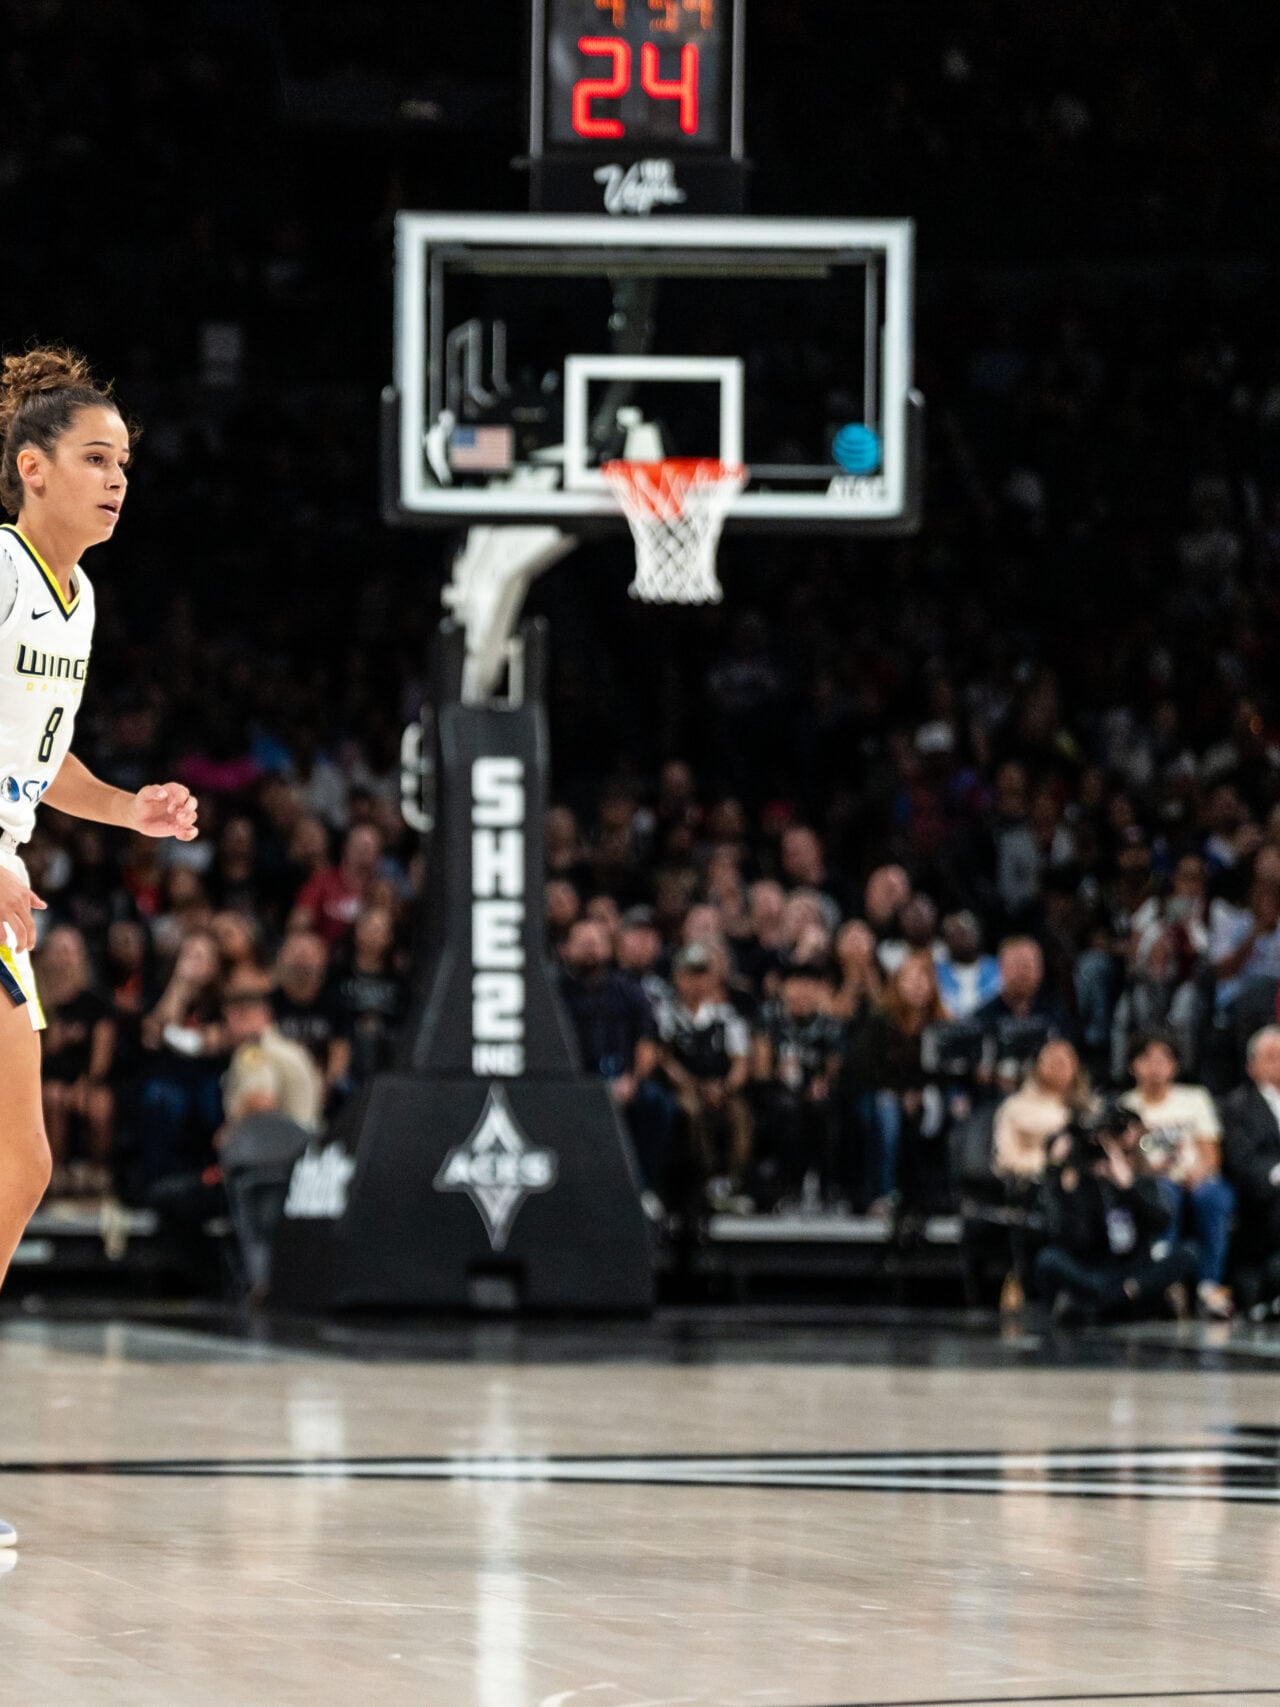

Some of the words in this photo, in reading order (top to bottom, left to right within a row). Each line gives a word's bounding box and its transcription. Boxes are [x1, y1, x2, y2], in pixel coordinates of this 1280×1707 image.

[572, 36, 699, 139] 24
[16, 642, 86, 681] WING
[37, 706, 65, 763] 8
